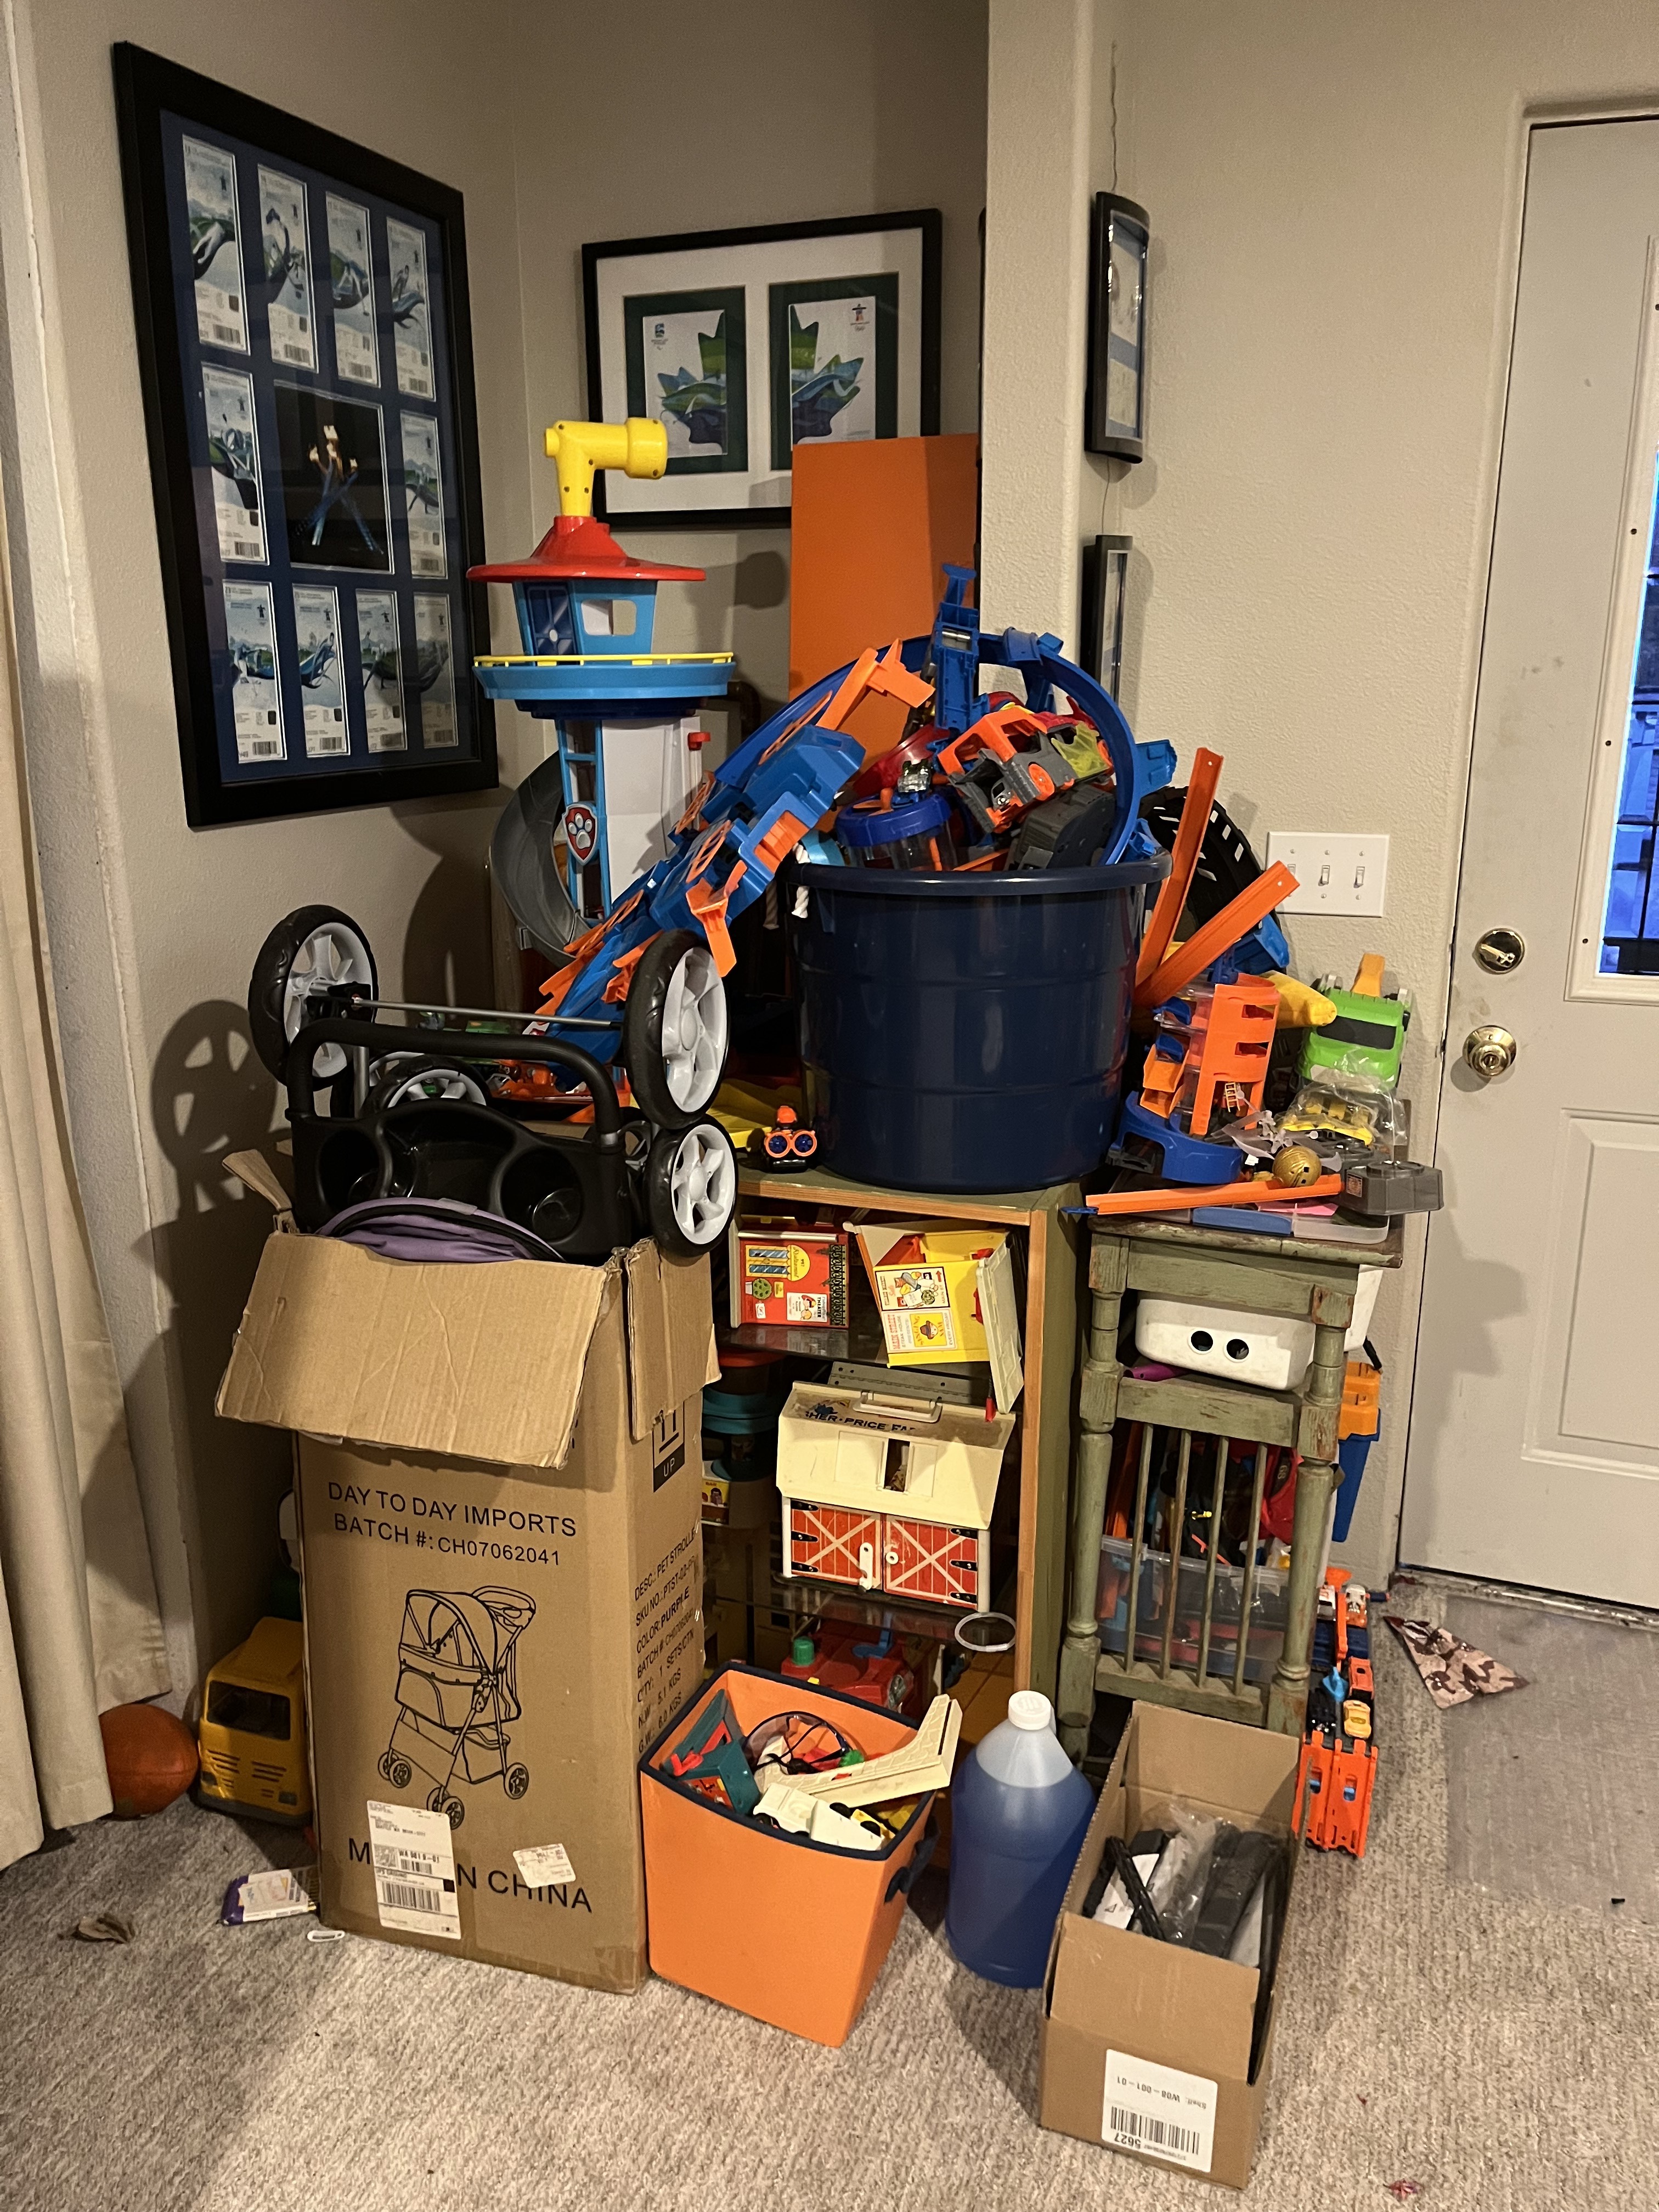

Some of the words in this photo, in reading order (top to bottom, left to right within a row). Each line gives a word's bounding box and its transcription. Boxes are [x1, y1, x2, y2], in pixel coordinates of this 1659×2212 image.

[888, 1314, 898, 1333] STREET
[663, 1457, 675, 1477] UP
[329, 1482, 370, 1506] DAY
[376, 1490, 406, 1513] TO
[413, 1497, 457, 1521] DAY
[465, 1505, 576, 1536] IMPORTS
[334, 1513, 409, 1544] BATCH
[657, 1555, 669, 1578] PET
[636, 1602, 649, 1627] SKU
[637, 1647, 659, 1679] BATCH
[659, 1665, 663, 1677] 1
[668, 1668, 681, 1691] KGS
[669, 1691, 681, 1714] KGS
[456, 1863, 476, 1889] N
[488, 1870, 592, 1914] CHINA
[1114, 2132, 1141, 2149] 5627
